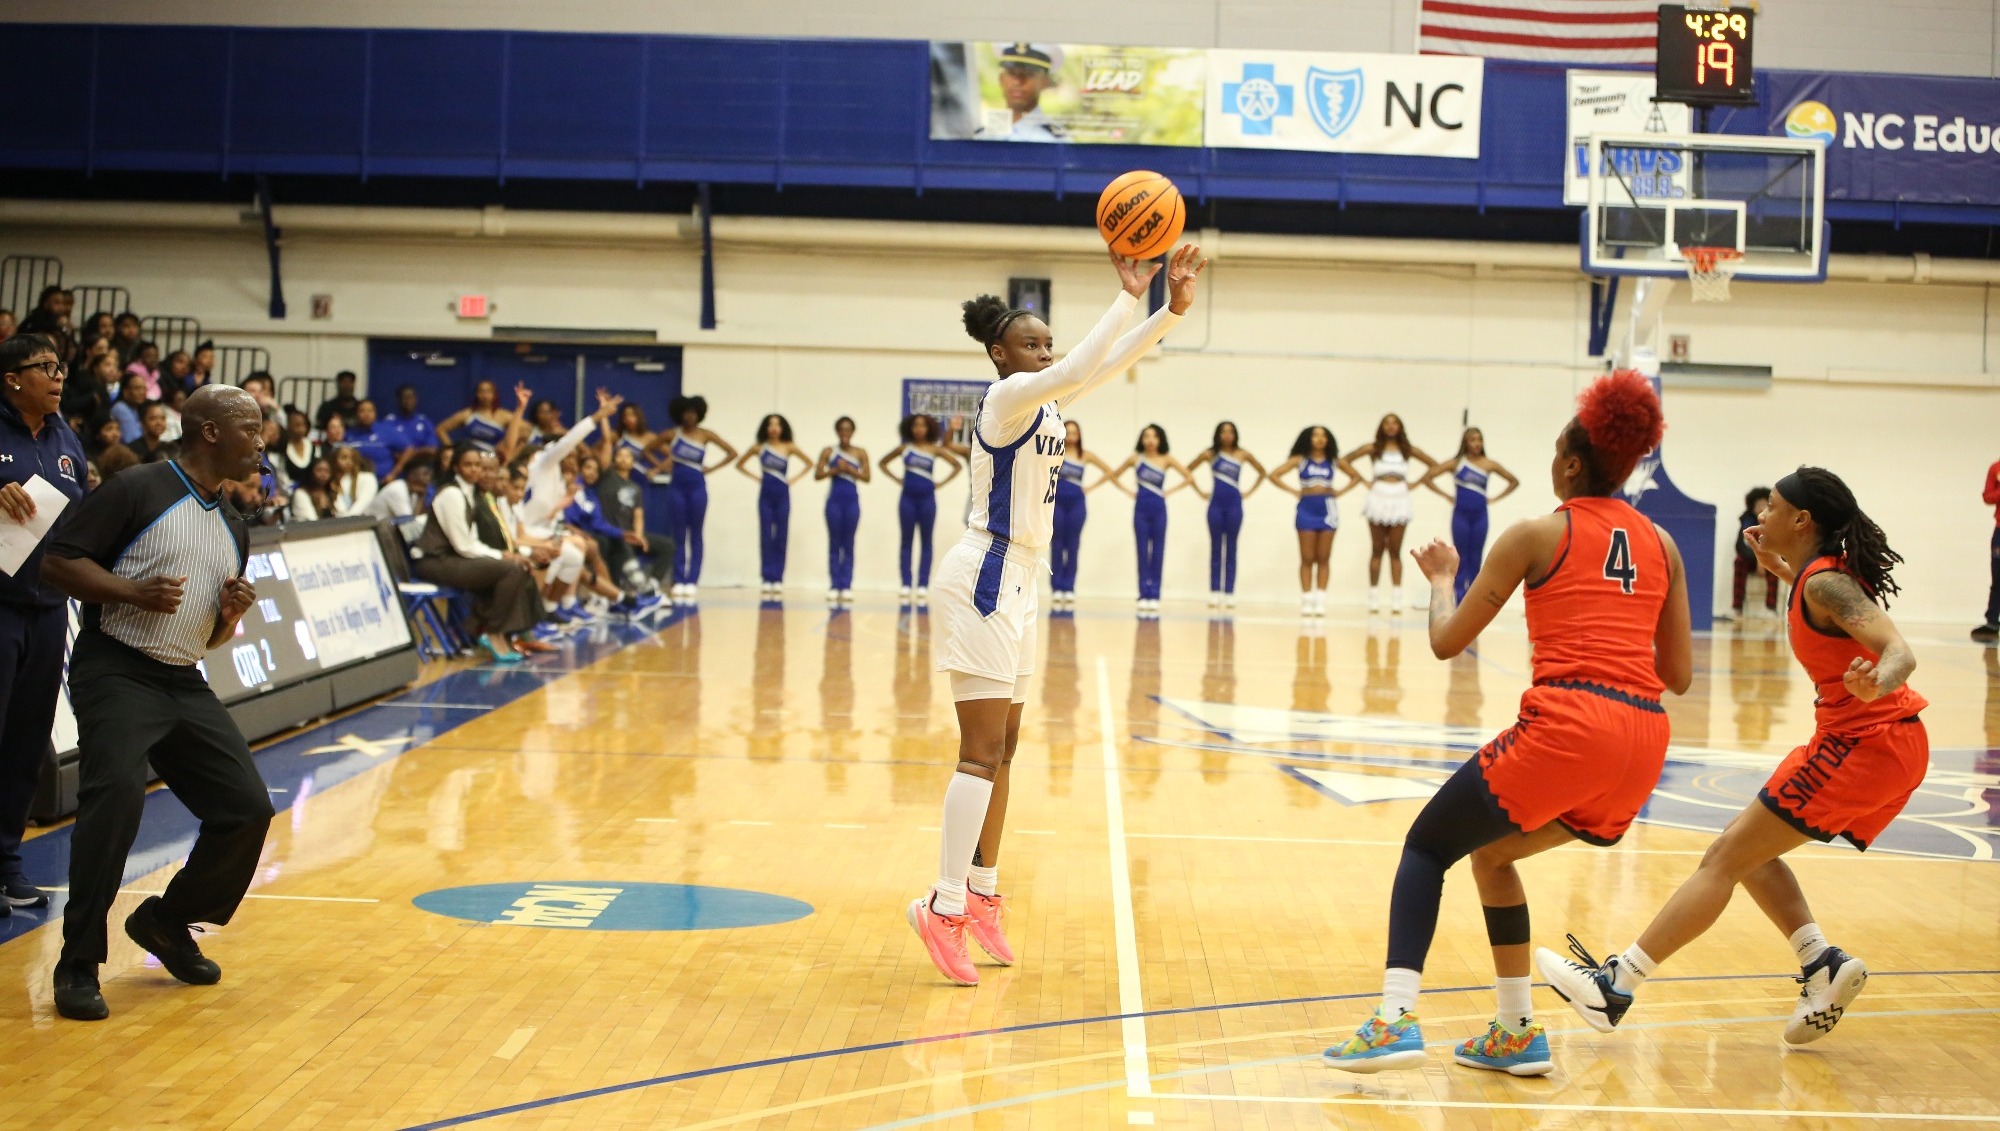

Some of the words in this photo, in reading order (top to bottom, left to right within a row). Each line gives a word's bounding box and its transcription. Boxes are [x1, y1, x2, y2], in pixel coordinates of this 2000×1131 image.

[1686, 13, 1746, 40] 4:29
[1085, 71, 1142, 91] LEAD
[1697, 42, 1733, 86] 19
[1385, 81, 1463, 130] NC
[1843, 112, 1905, 150] NC
[1103, 190, 1149, 232] Wilson
[1127, 211, 1163, 247] NCAA
[1603, 528, 1637, 595] 4
[232, 644, 268, 687] QTR
[260, 638, 276, 671] 2
[491, 884, 624, 928] NCAA
